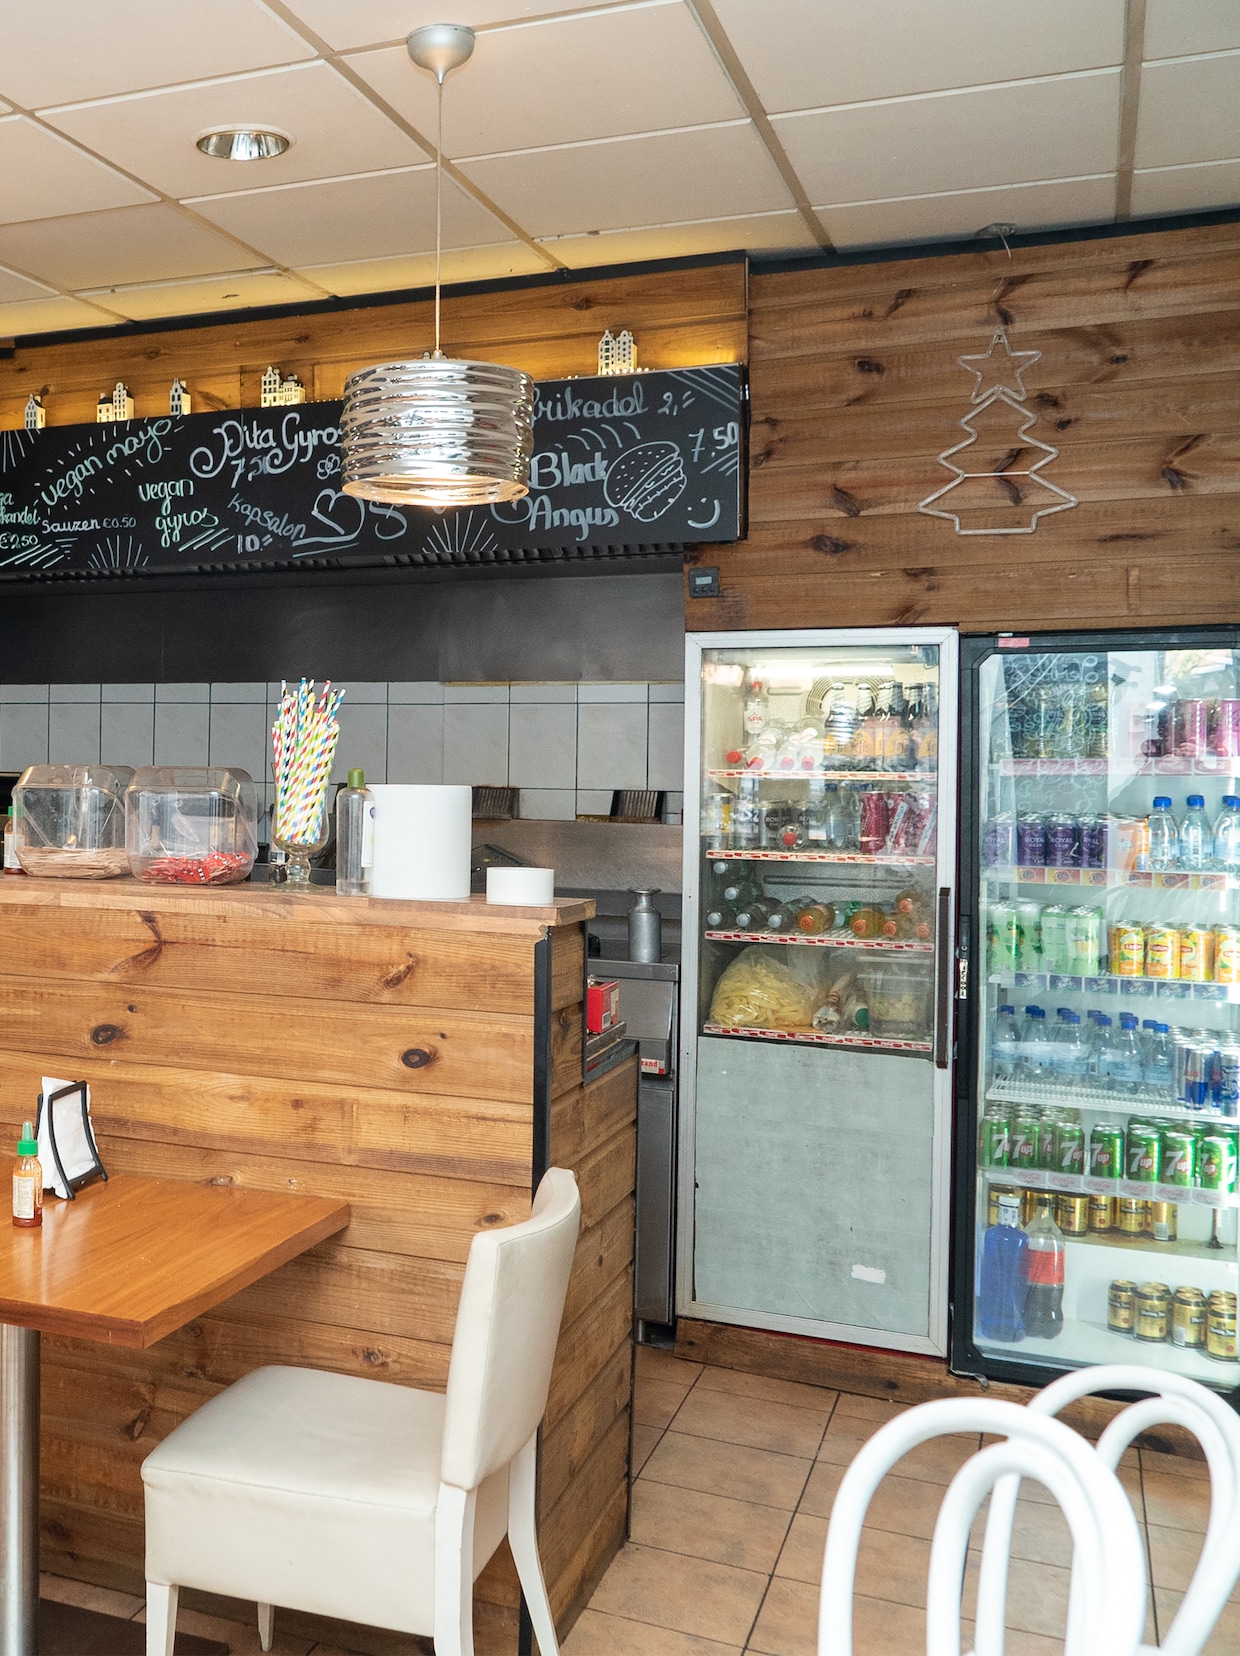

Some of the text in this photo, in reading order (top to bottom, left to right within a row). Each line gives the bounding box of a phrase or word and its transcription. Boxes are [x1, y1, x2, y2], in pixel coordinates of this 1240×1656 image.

[41, 418, 172, 506] vegan mayo
[190, 420, 277, 478] Pita
[529, 452, 608, 490] Black
[138, 478, 194, 515] vegan
[505, 494, 620, 541] Angus
[155, 508, 219, 548] gyros
